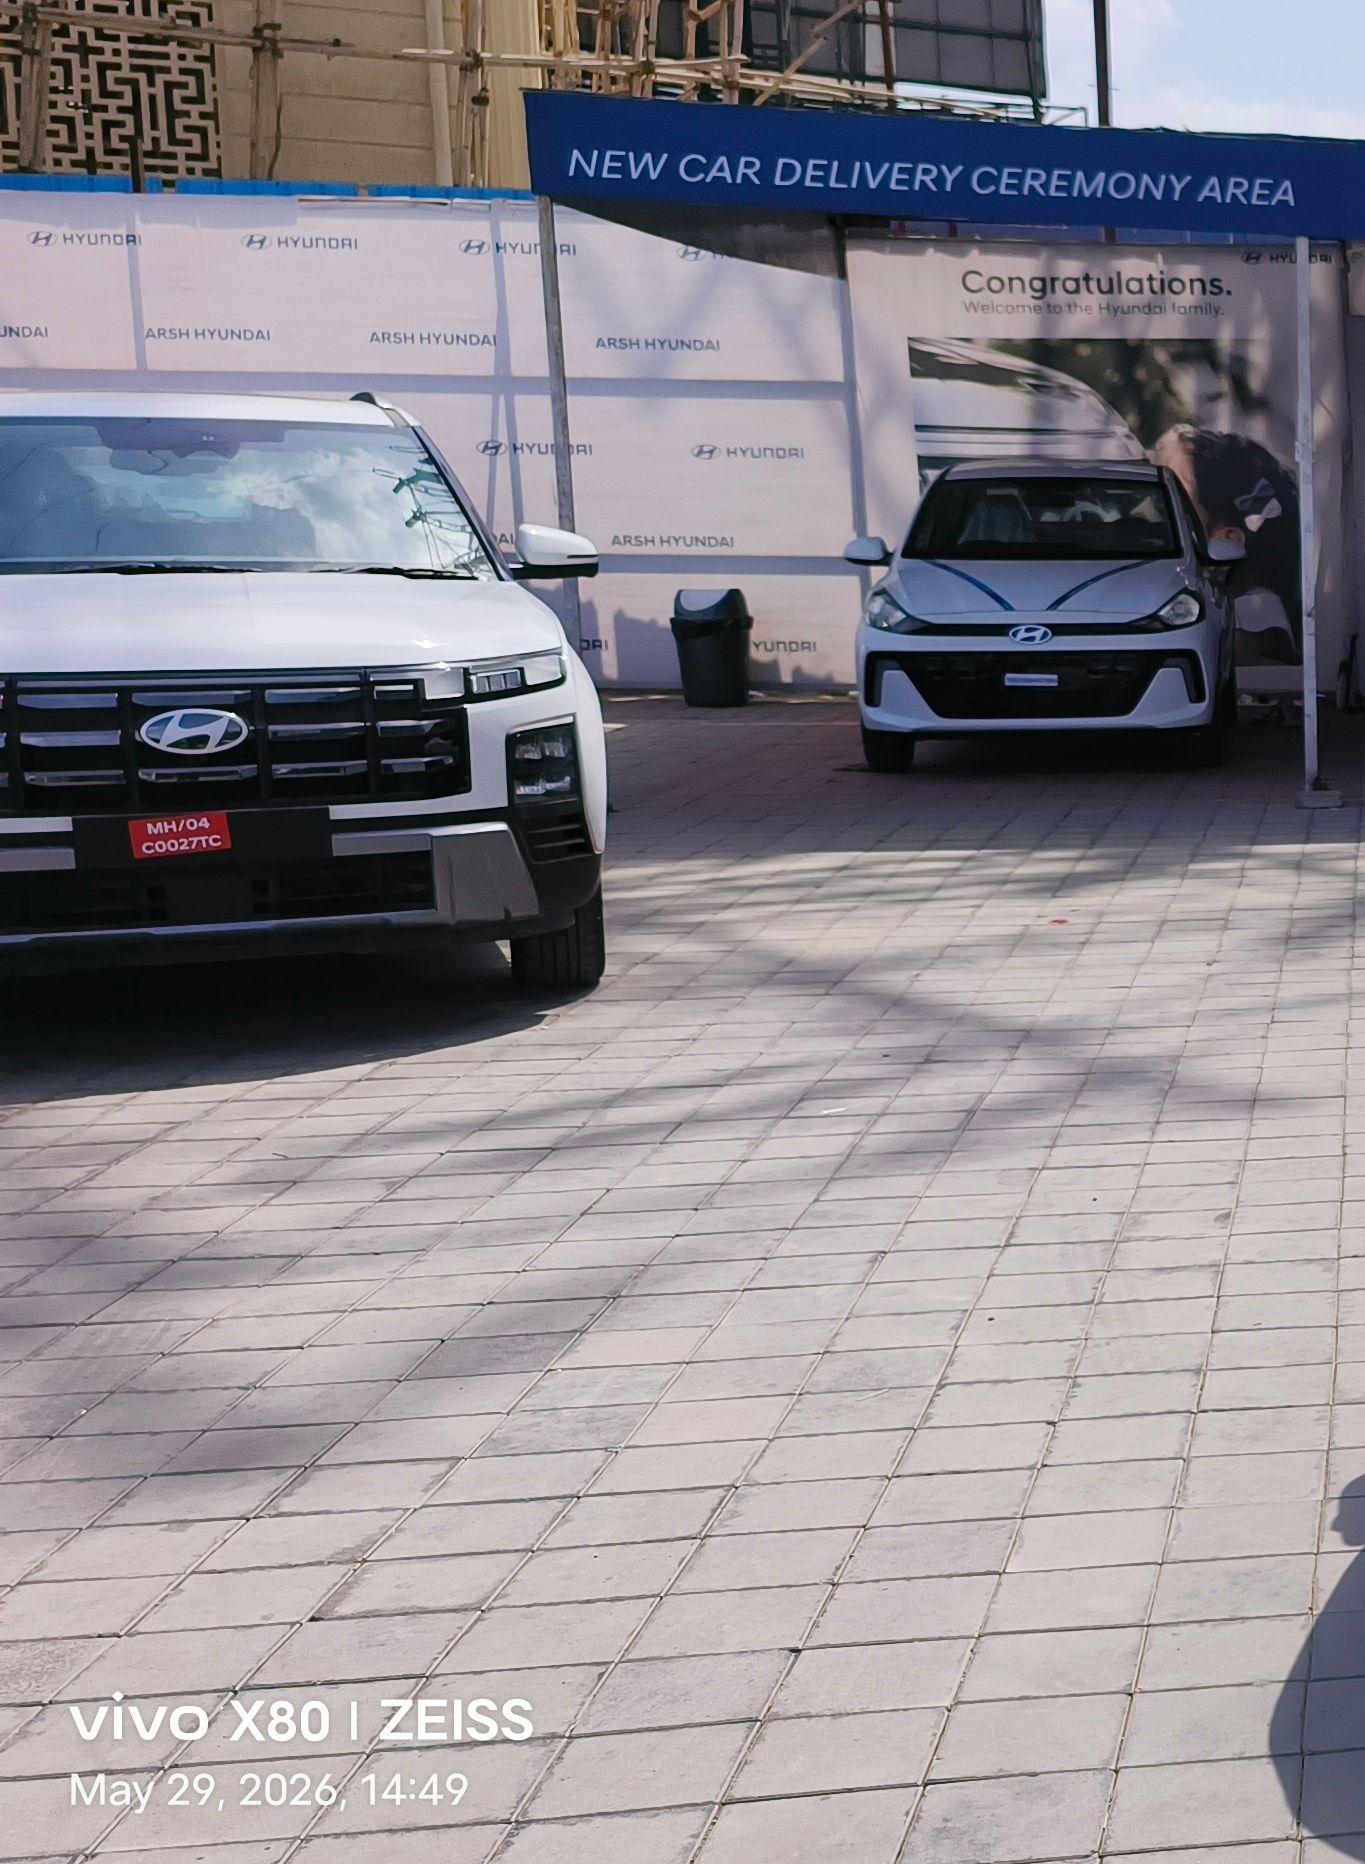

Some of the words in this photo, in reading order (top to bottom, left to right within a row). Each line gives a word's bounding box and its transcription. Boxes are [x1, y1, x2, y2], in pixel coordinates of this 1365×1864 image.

[568, 149, 668, 180] NEW
[679, 153, 760, 185] CAR
[774, 158, 963, 192] DELIVERY
[971, 166, 1192, 202] CEREMONY
[1199, 176, 1296, 207] AREA
[63, 234, 141, 246] HYUNDAI
[277, 236, 358, 250] HYUNDAI
[1269, 252, 1332, 264] HYUDAI
[962, 270, 1233, 300] Congratulations.
[963, 301, 1042, 315] Welcome
[1047, 302, 1063, 315] to
[1067, 301, 1092, 315] the
[1099, 302, 1167, 317] Hyundai
[1171, 301, 1225, 318] family.
[0, 326, 48, 338] UNDAI
[145, 327, 190, 340] ARSH
[194, 329, 271, 341] HYUNDAI
[370, 331, 415, 345] ARSH
[420, 332, 497, 347] HYUNDAI
[595, 337, 640, 350] ARSH
[644, 339, 720, 351] HYUNDAI
[726, 446, 805, 459] HYUNDAI
[612, 535, 656, 547] ARSH
[660, 535, 734, 549] HYUNDAI
[752, 639, 817, 653] YUNDAI
[146, 816, 211, 835] MH/04
[141, 834, 222, 855] C0027TC
